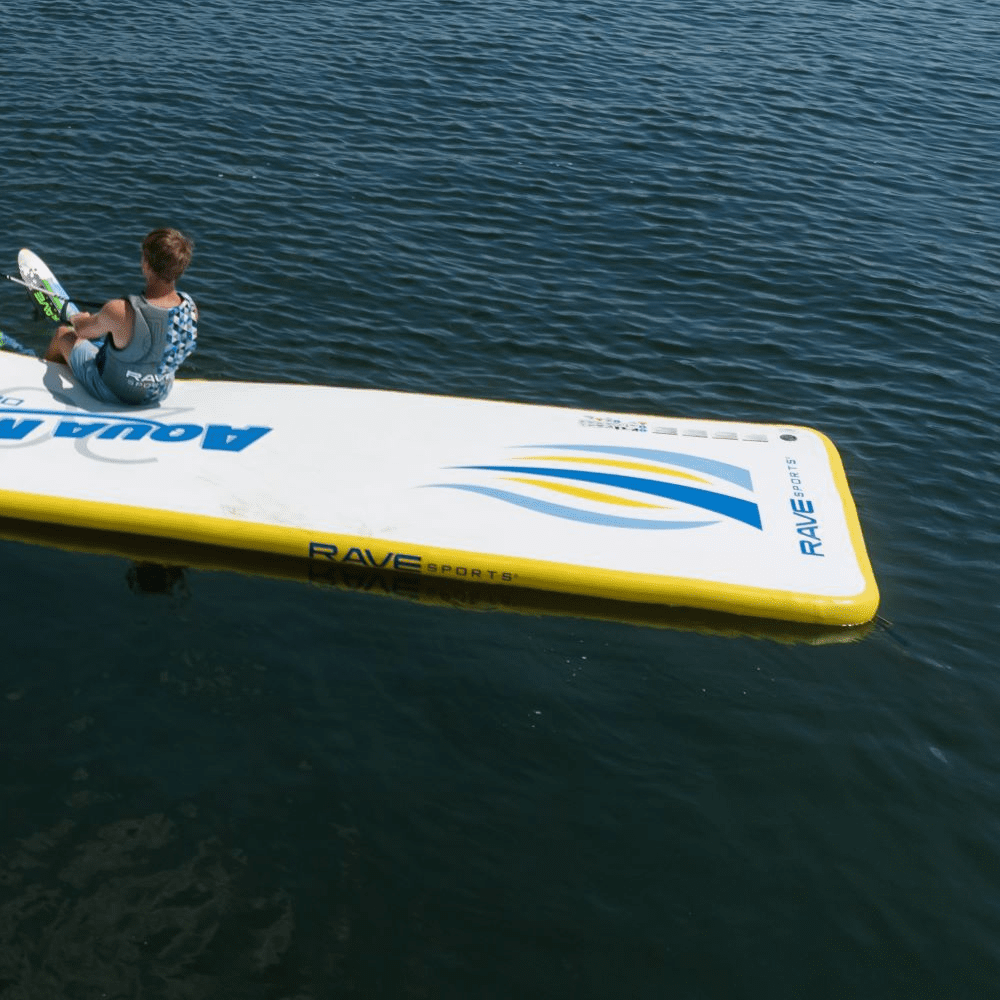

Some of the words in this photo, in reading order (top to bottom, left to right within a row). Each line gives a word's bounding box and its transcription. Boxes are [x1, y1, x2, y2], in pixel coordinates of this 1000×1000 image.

[53, 419, 272, 452] AQUA
[786, 457, 804, 497] SPORTS
[790, 498, 825, 557] RAVE
[308, 541, 421, 570] RAVE
[427, 563, 514, 582] SPORTS
